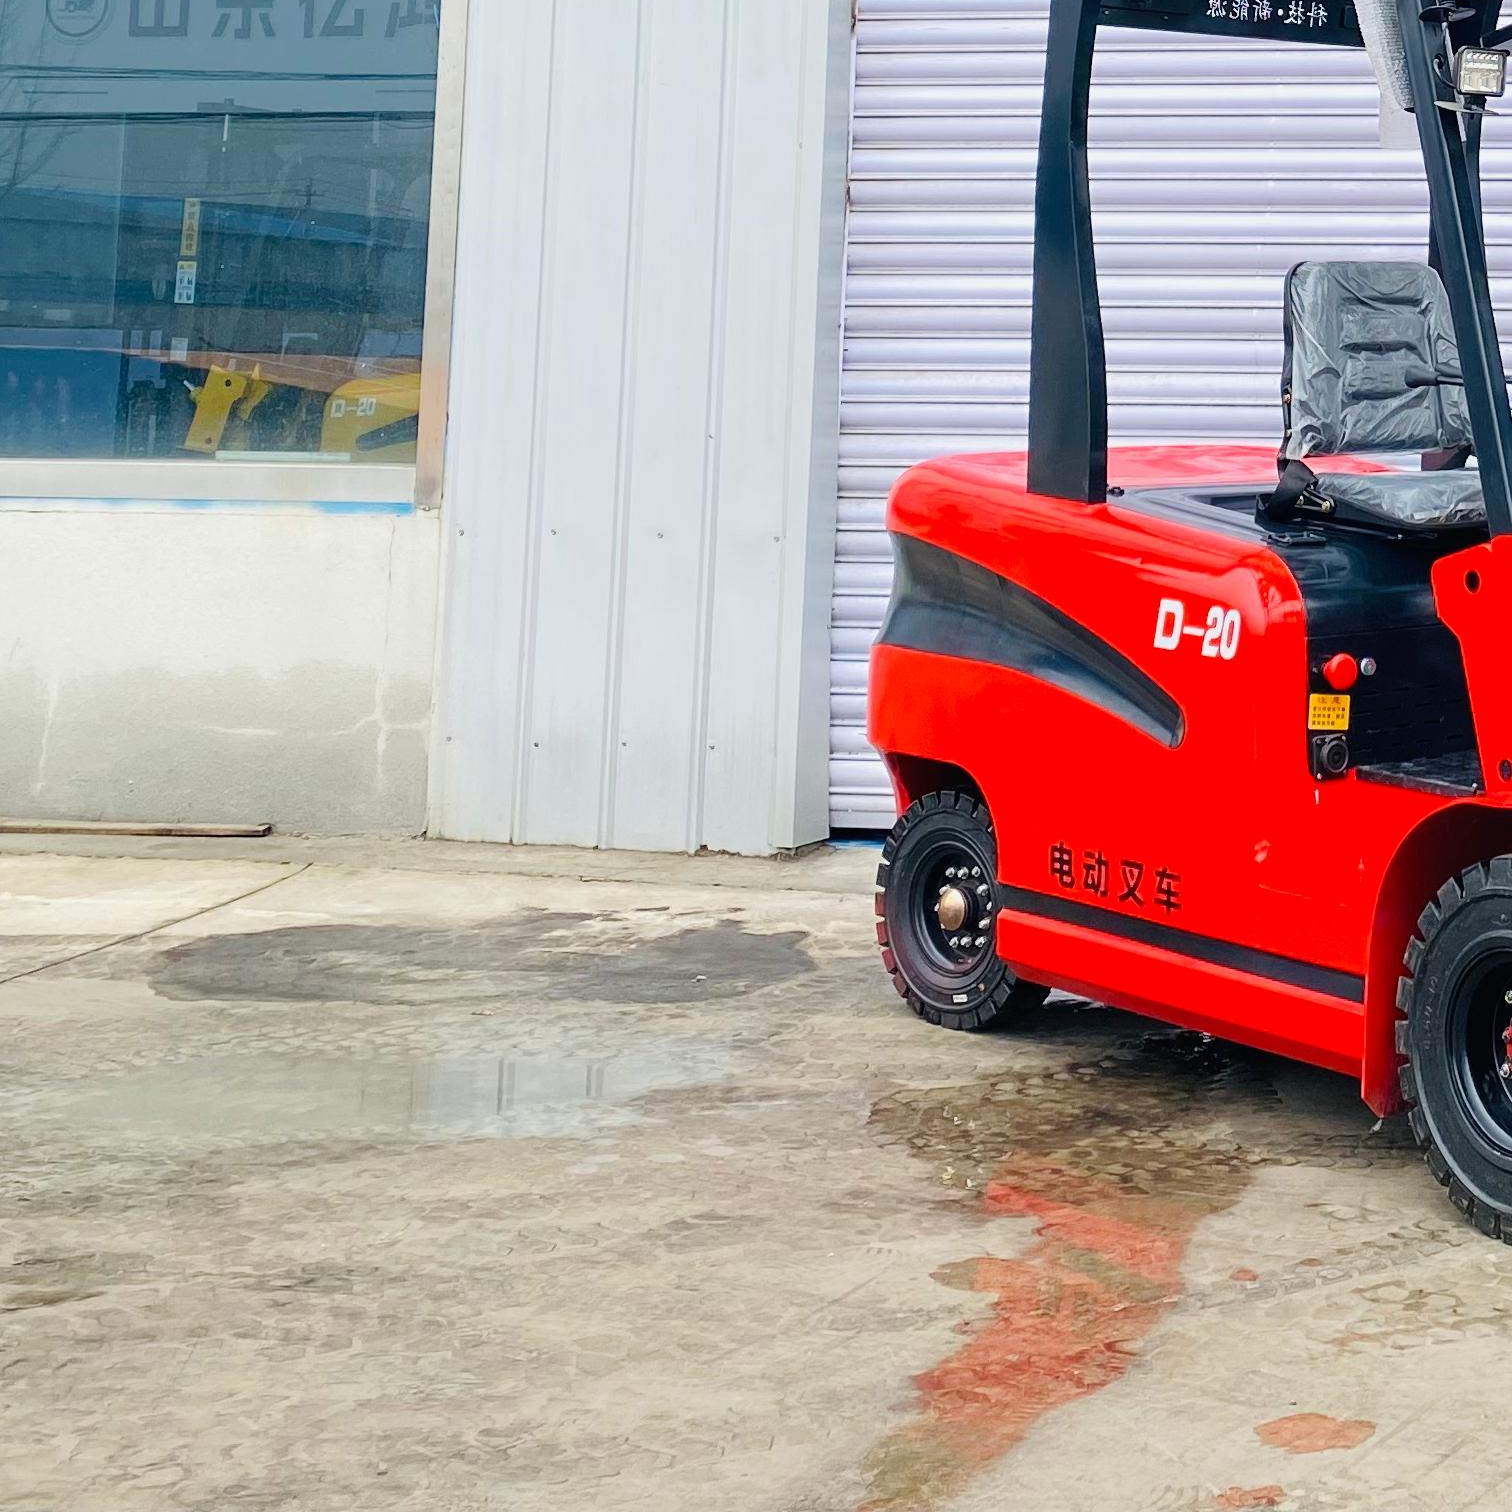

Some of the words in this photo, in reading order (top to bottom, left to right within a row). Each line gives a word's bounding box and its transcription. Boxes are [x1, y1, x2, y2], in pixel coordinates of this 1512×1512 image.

[330, 396, 377, 418] D-20
[1153, 598, 1241, 661] D-20
[1048, 840, 1183, 915] 电动叉车
